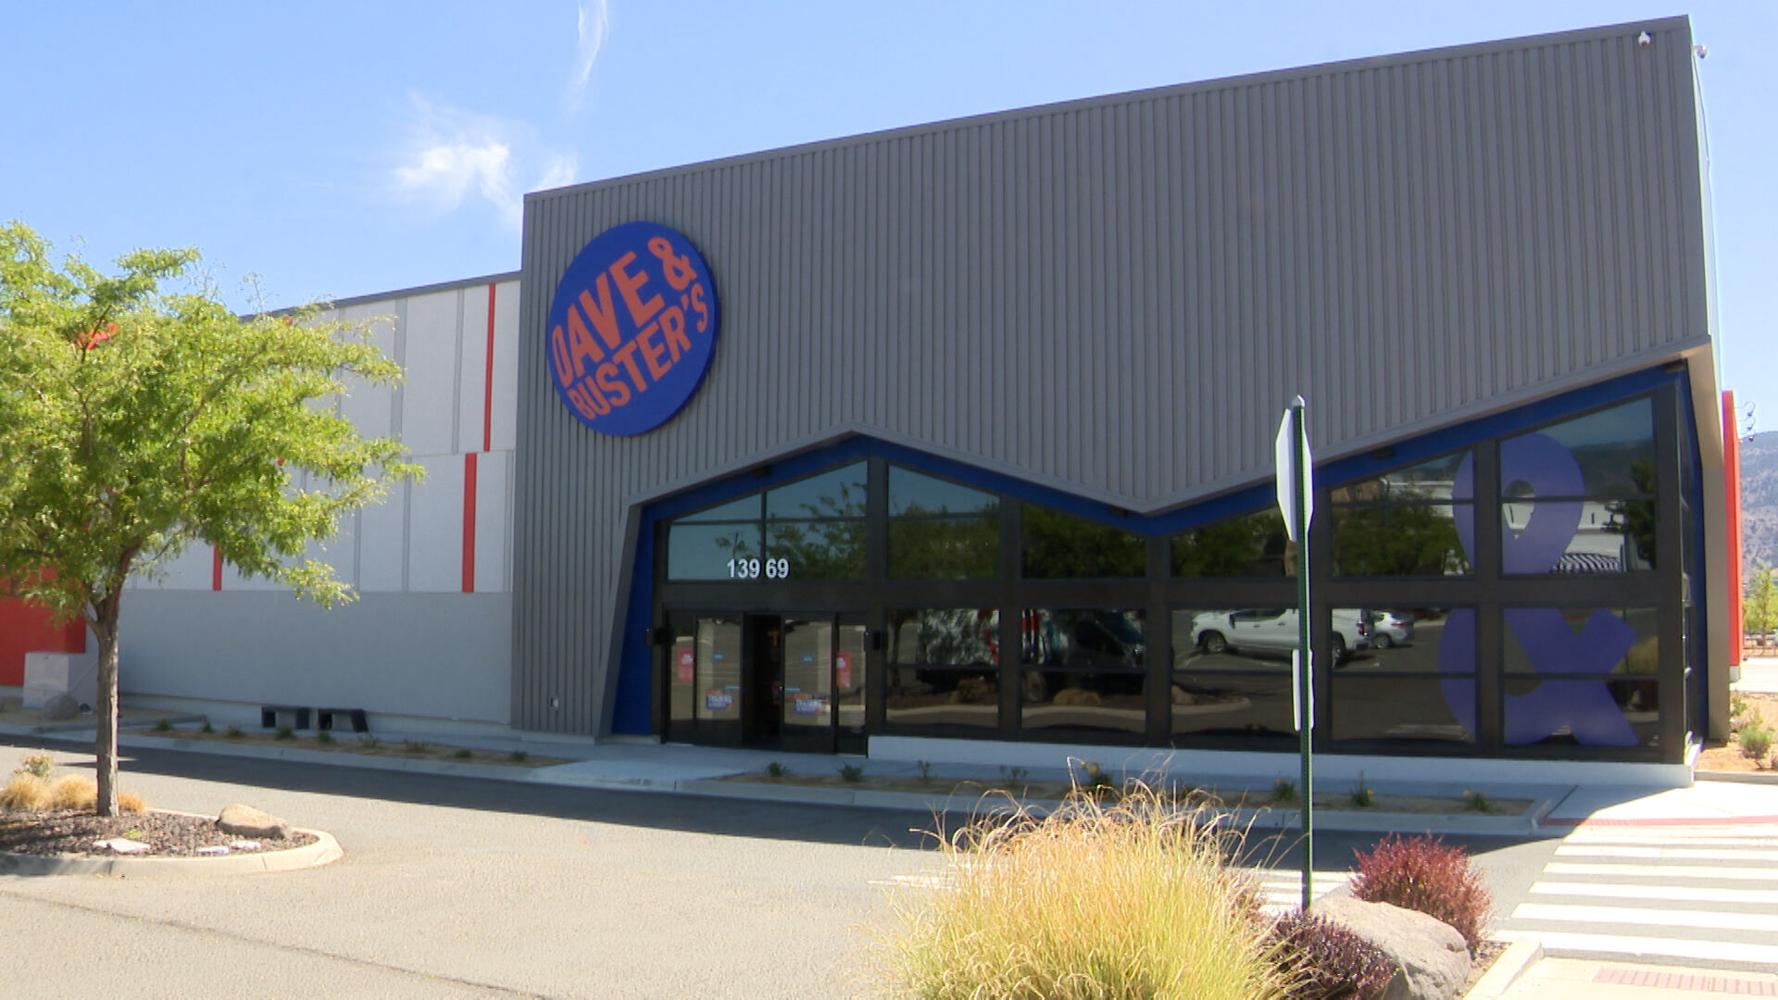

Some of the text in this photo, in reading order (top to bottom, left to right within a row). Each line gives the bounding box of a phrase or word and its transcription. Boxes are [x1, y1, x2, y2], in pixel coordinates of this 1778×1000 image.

[551, 236, 697, 388] DAVE &
[567, 283, 708, 421] BUSTER'S
